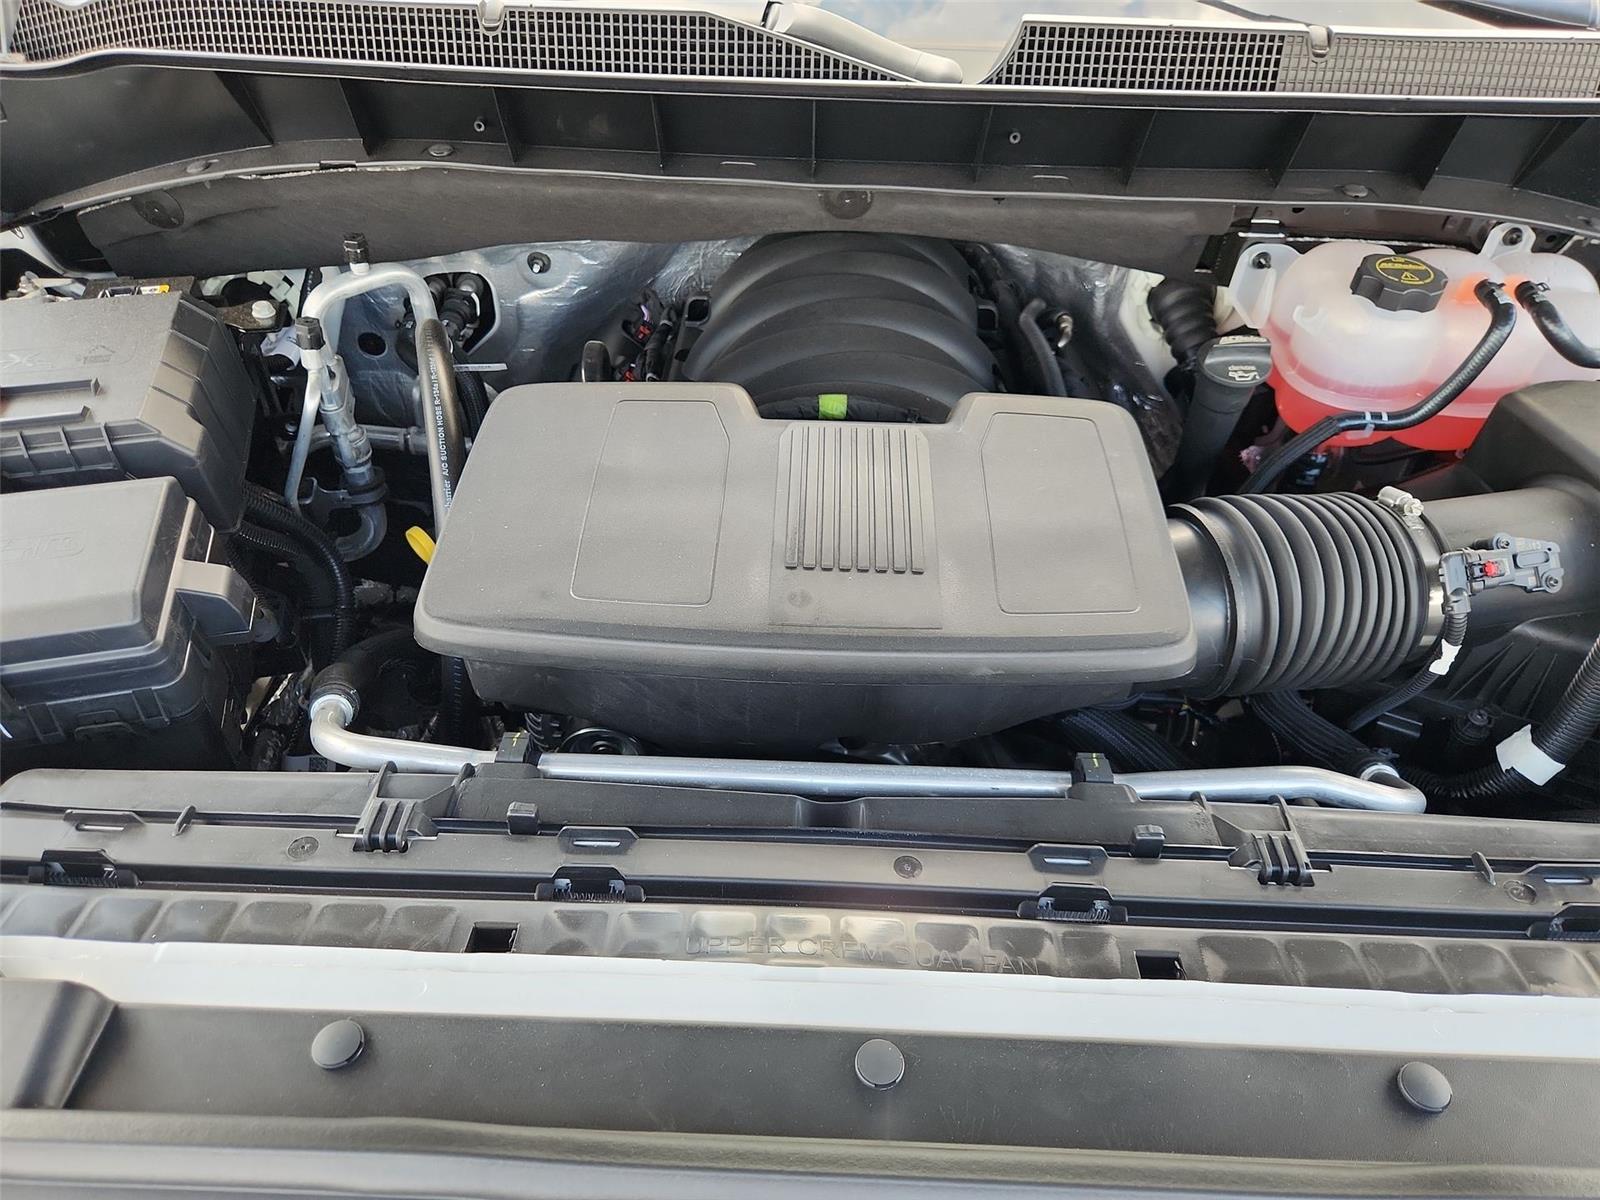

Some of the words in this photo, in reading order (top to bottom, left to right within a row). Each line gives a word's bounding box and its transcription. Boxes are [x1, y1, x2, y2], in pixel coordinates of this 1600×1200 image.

[435, 406, 443, 425] HOSE
[438, 427, 447, 461] SUCTION
[684, 936, 787, 955] UPPER
[982, 952, 1039, 976] FAN
